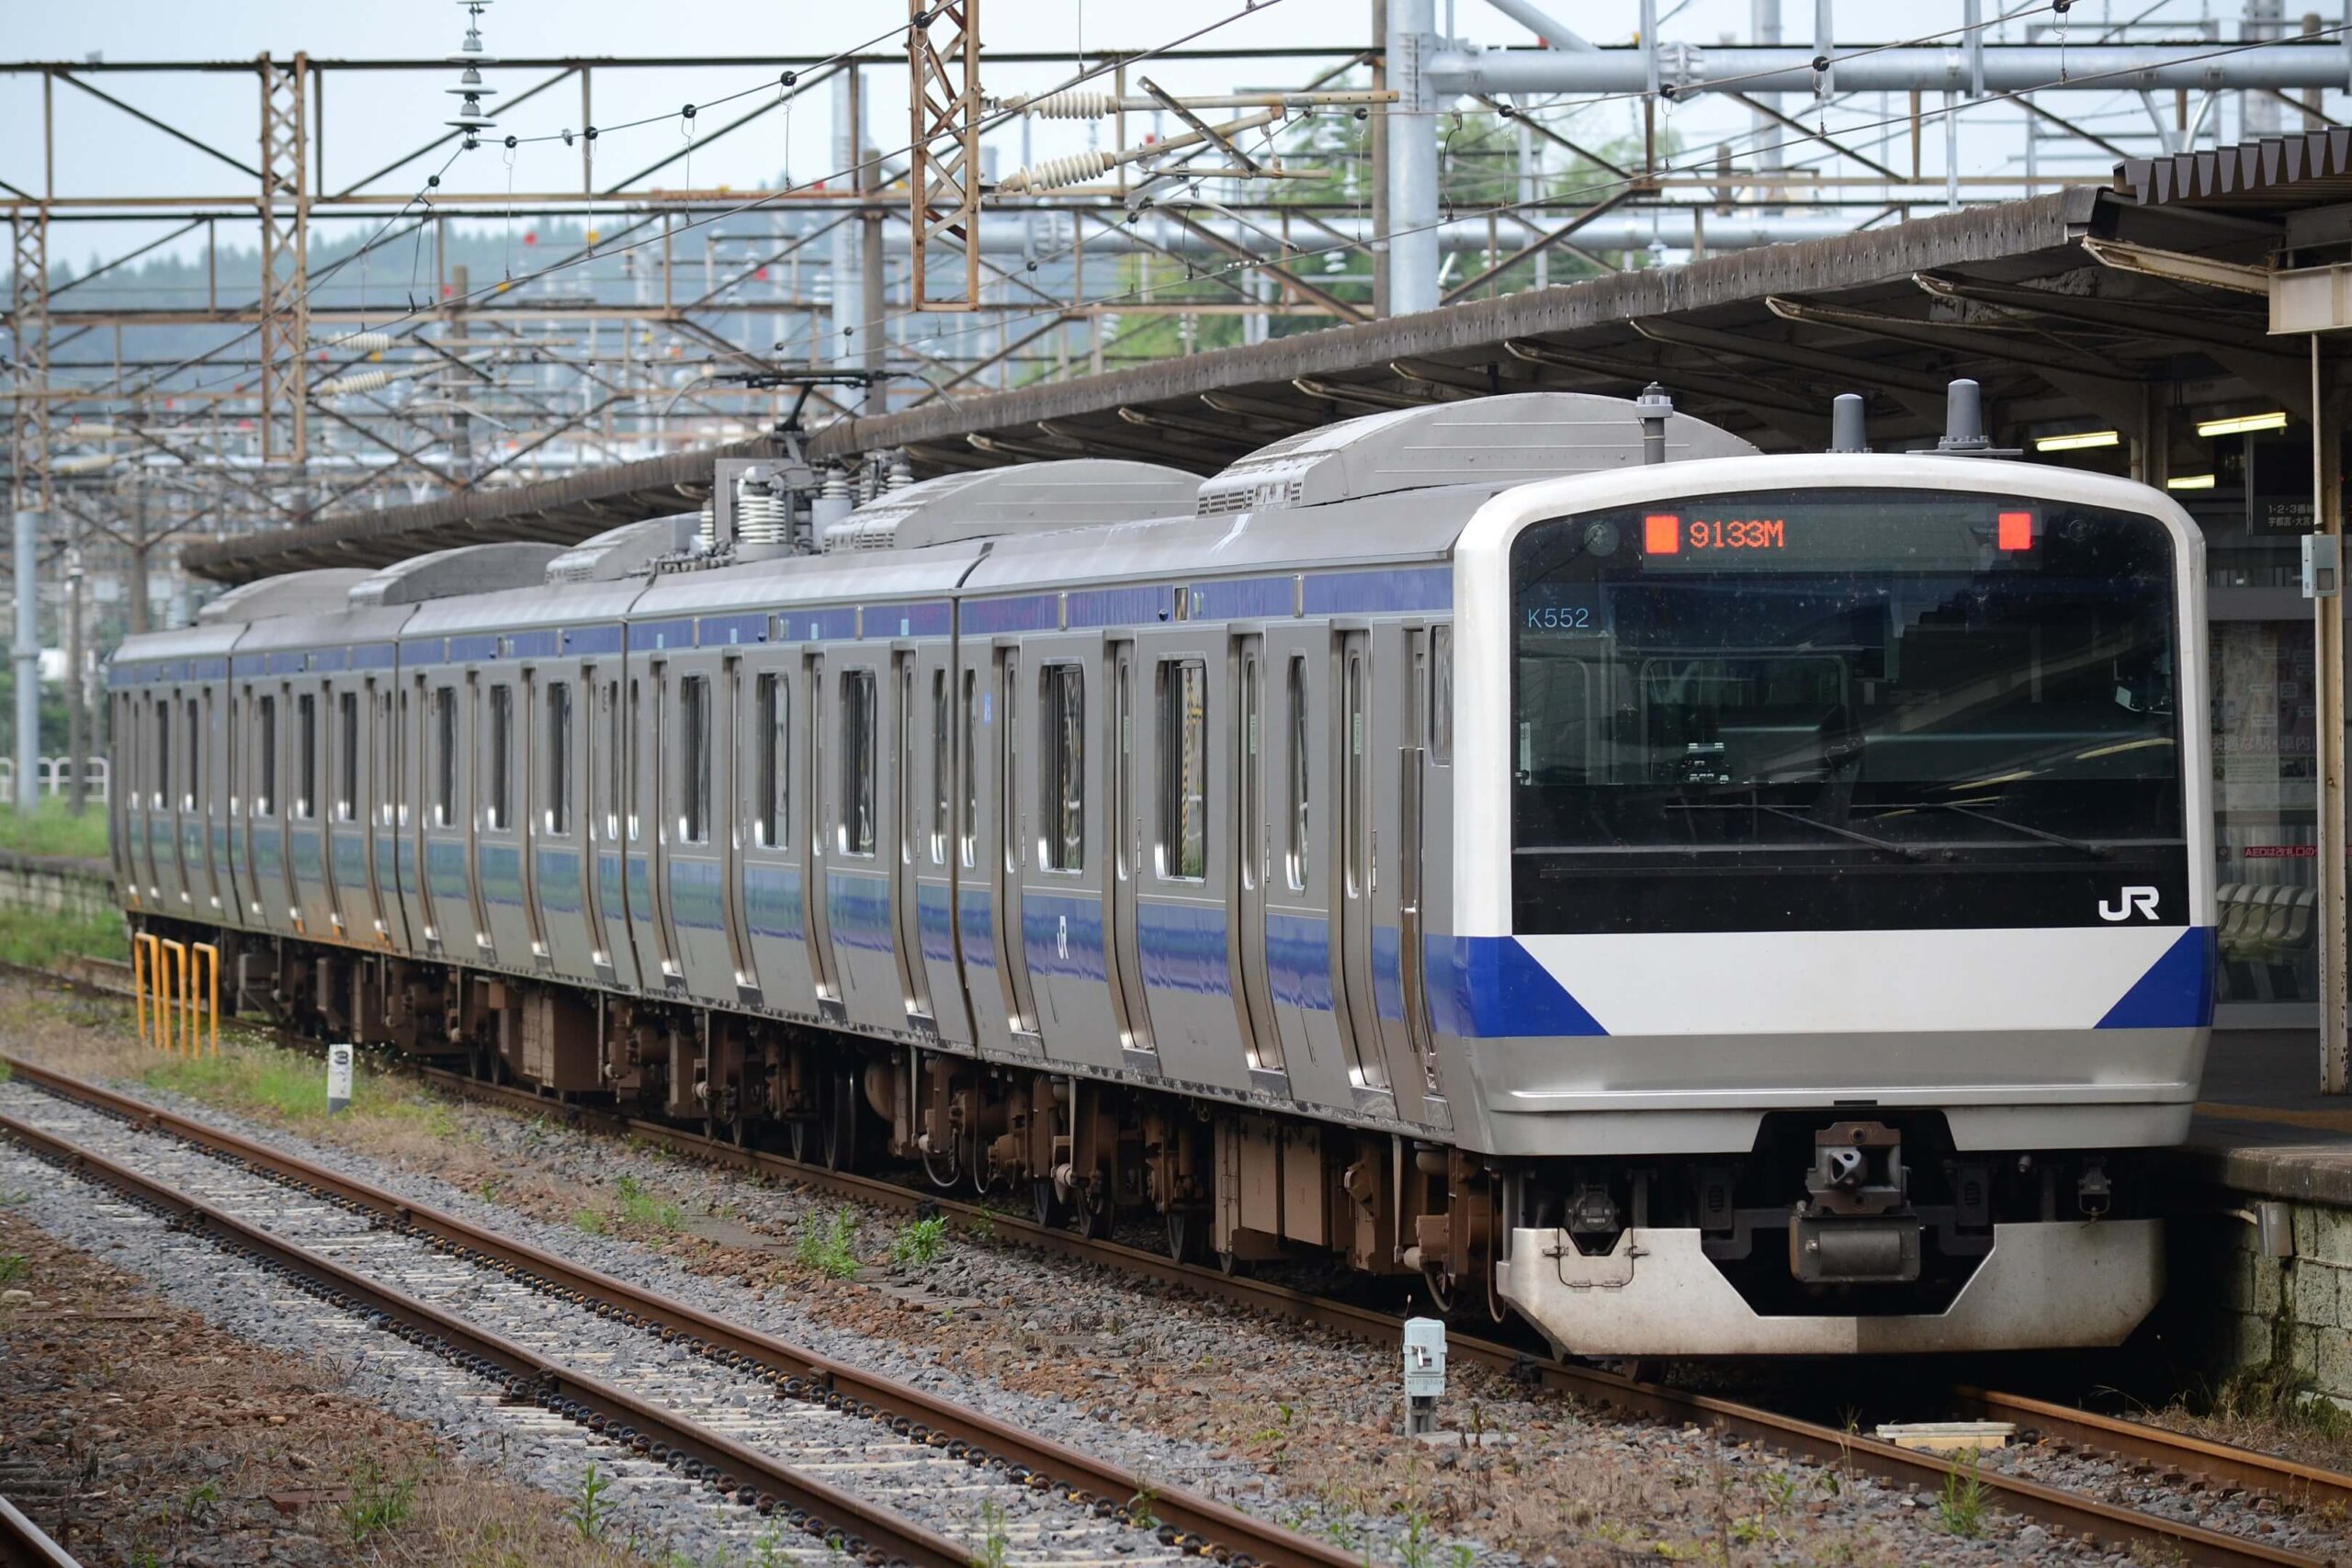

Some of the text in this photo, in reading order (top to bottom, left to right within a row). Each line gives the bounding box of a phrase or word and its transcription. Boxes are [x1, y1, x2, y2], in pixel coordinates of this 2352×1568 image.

[1690, 519, 1784, 547] 9133M
[1528, 608, 1589, 628] K552
[2098, 886, 2160, 921] JR
[1057, 915, 1069, 960] JR
